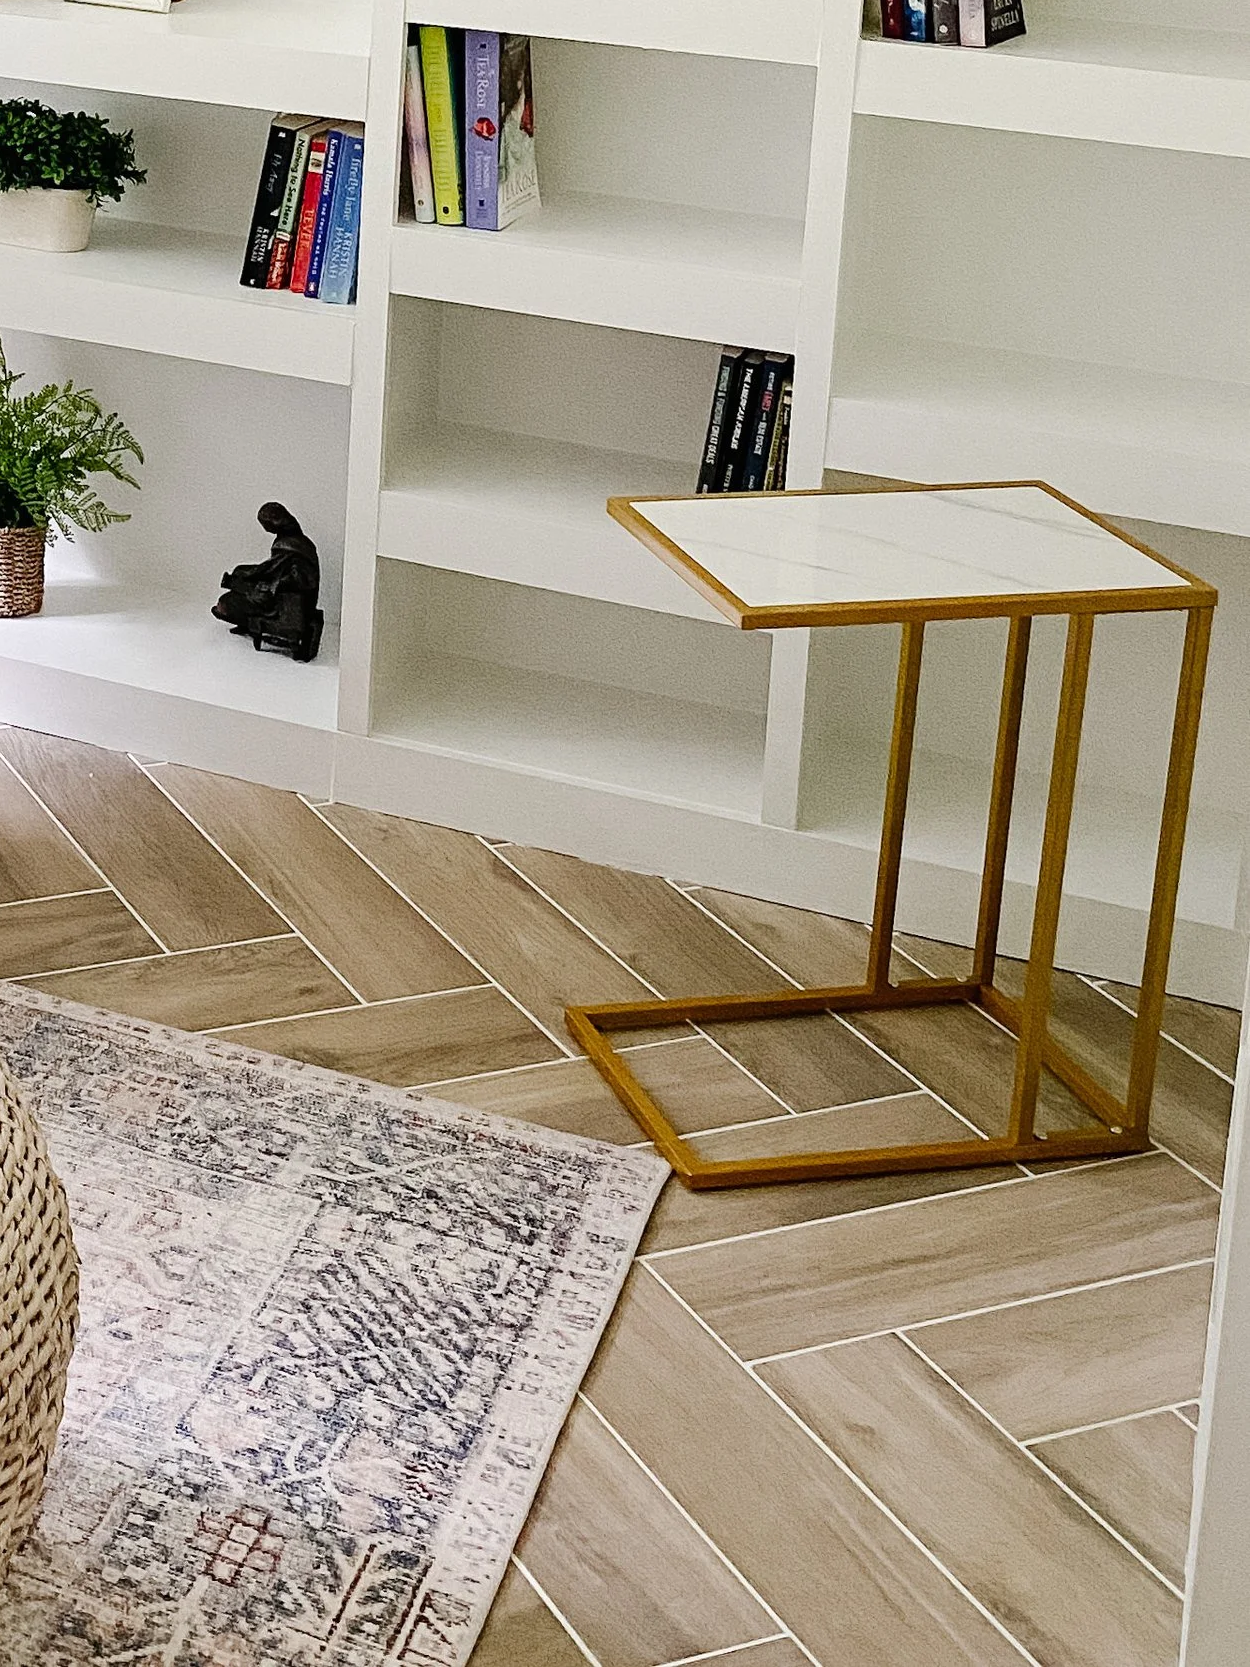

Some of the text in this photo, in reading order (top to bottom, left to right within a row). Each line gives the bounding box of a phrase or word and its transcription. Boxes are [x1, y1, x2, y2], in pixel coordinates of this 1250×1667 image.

[475, 55, 490, 78] TEA
[327, 138, 339, 171] Kamala
[280, 138, 306, 226] Nothing to See Here
[328, 226, 344, 279] HANNAH
[342, 230, 354, 277] KRISTIN
[708, 425, 720, 446] GREAT
[704, 444, 716, 466] DEALS
